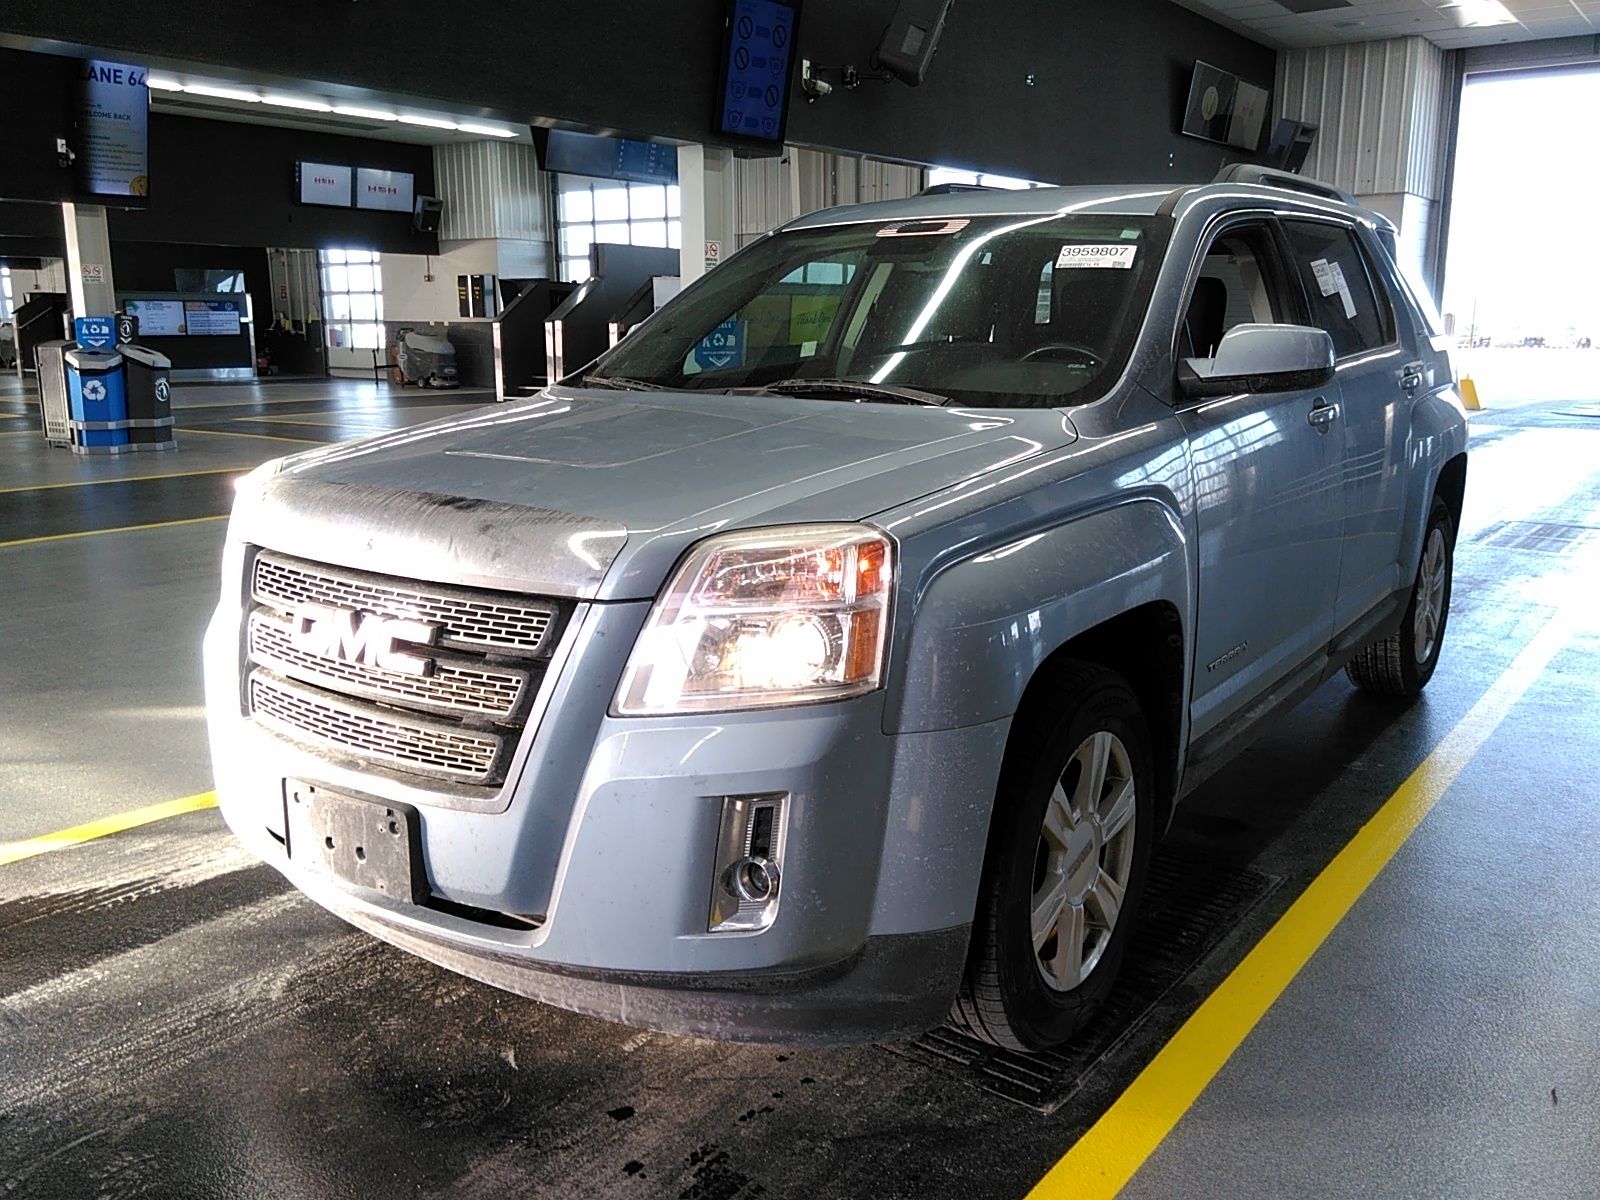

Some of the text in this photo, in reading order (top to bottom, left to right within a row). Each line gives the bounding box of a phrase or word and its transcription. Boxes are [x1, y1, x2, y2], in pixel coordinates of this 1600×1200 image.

[87, 66, 123, 85] ANE
[113, 112, 132, 121] BACK
[1061, 246, 1129, 257] 3959807
